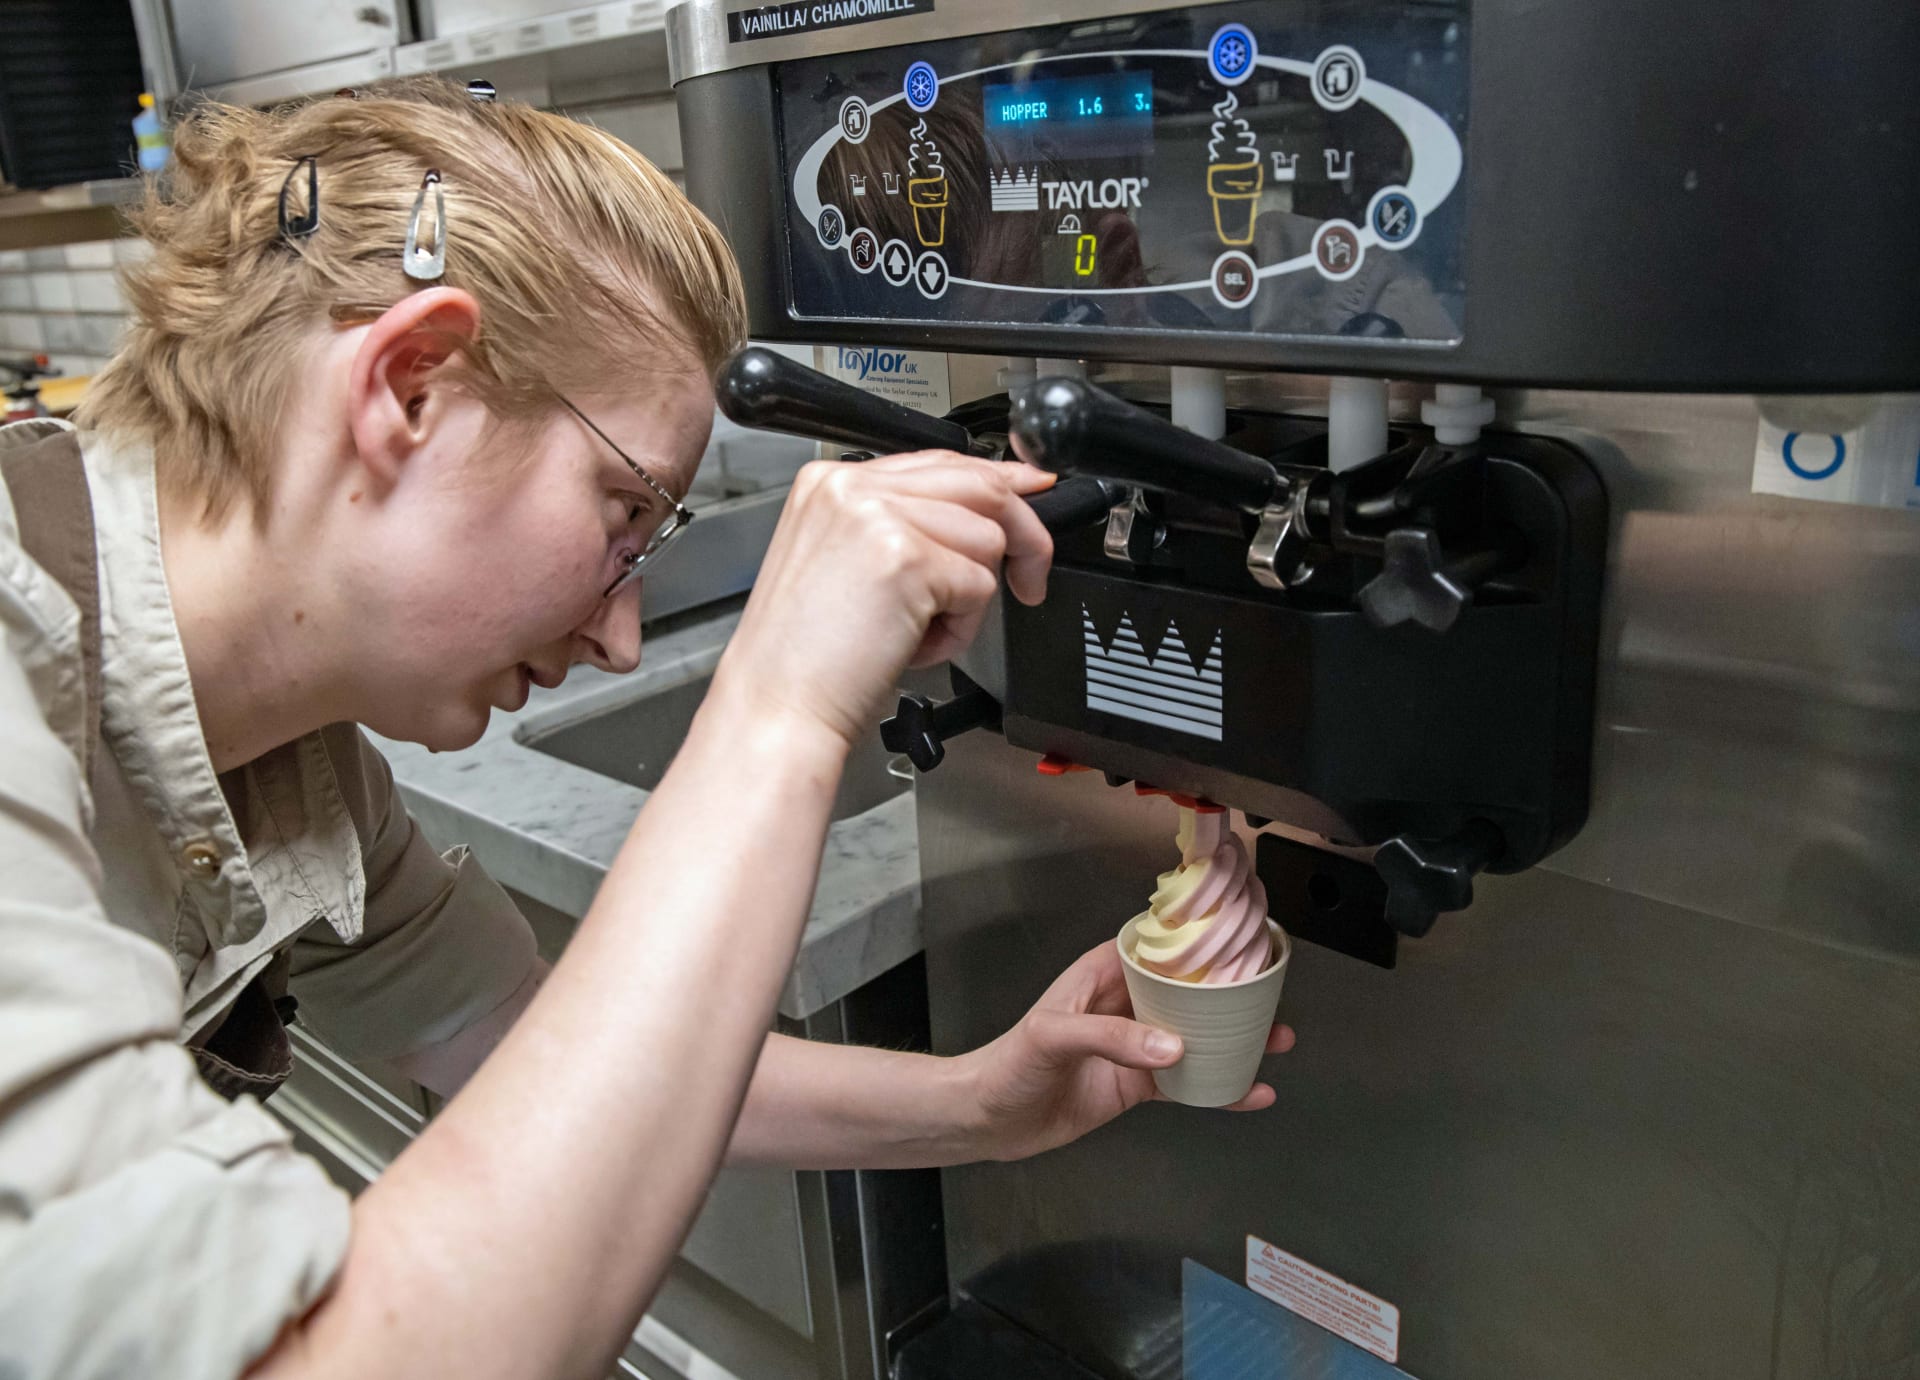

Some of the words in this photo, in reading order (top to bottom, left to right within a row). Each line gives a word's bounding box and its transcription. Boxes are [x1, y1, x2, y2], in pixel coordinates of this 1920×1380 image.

[741, 8, 807, 34] VAINILLA/
[1002, 102, 1047, 121] HOPPER
[1079, 96, 1103, 115] 1.6
[1075, 234, 1096, 275] 0
[1224, 273, 1245, 286] SEL
[905, 363, 918, 374] UK
